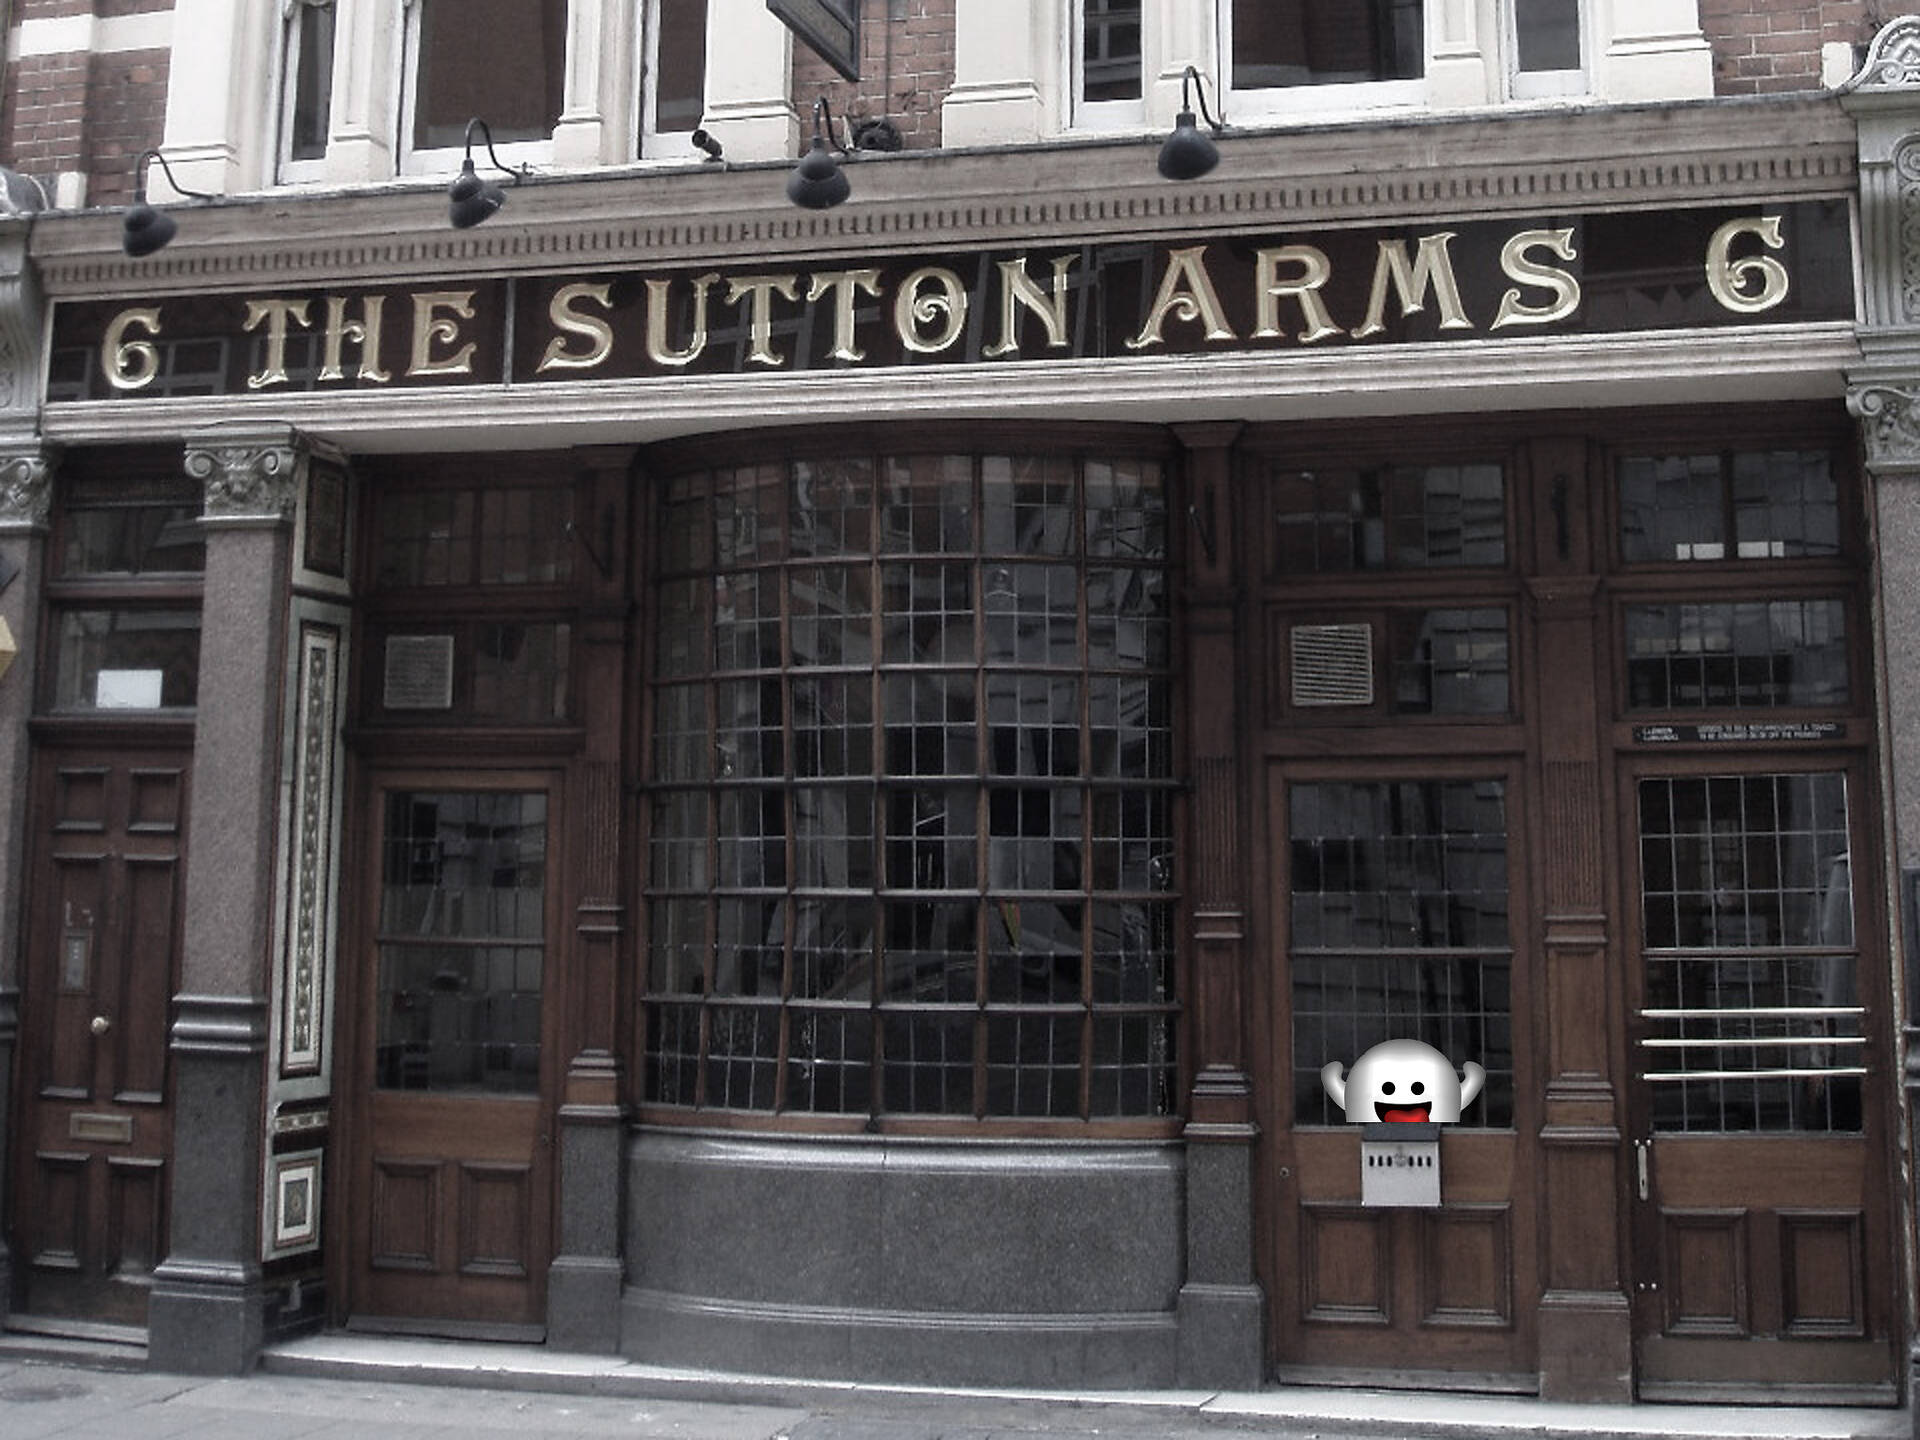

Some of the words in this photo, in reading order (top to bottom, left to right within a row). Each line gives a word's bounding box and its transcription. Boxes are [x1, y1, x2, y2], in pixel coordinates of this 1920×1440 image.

[103, 308, 161, 390] 6
[244, 291, 480, 387] THE
[536, 256, 1079, 373] SUTTON
[1125, 228, 1582, 348] ARMS
[1706, 216, 1789, 313] 6
